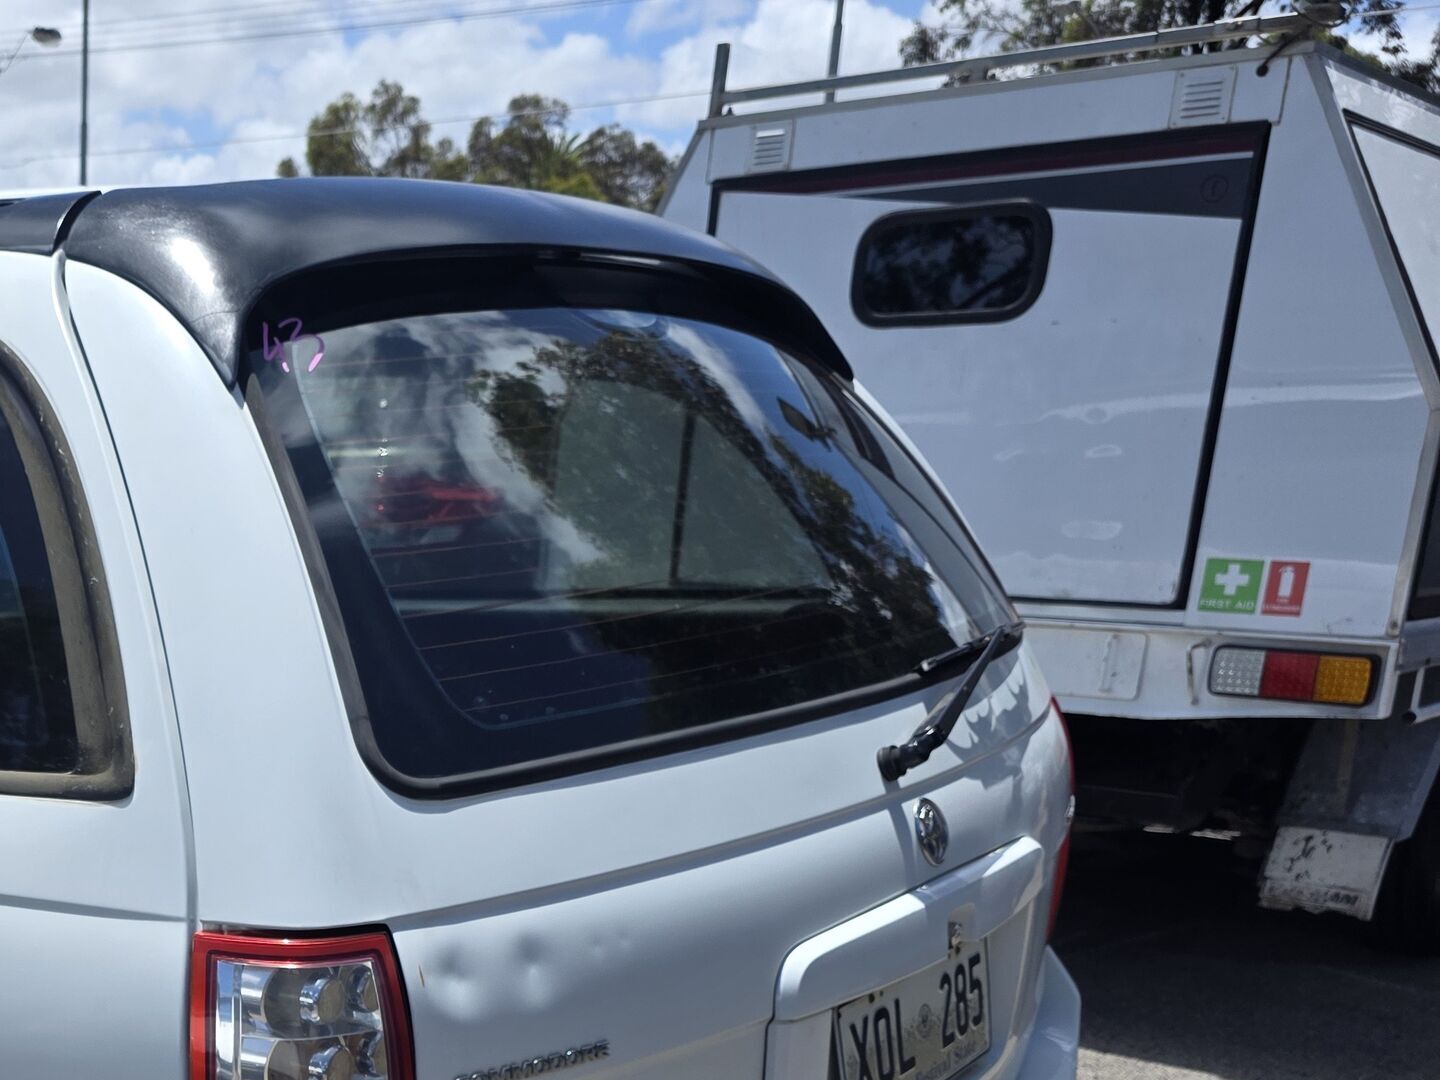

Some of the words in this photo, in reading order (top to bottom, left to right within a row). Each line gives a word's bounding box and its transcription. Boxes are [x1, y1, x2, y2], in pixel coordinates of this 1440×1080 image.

[1199, 599, 1232, 609] FIRST
[1235, 600, 1255, 610] AID
[938, 952, 985, 1049] 285
